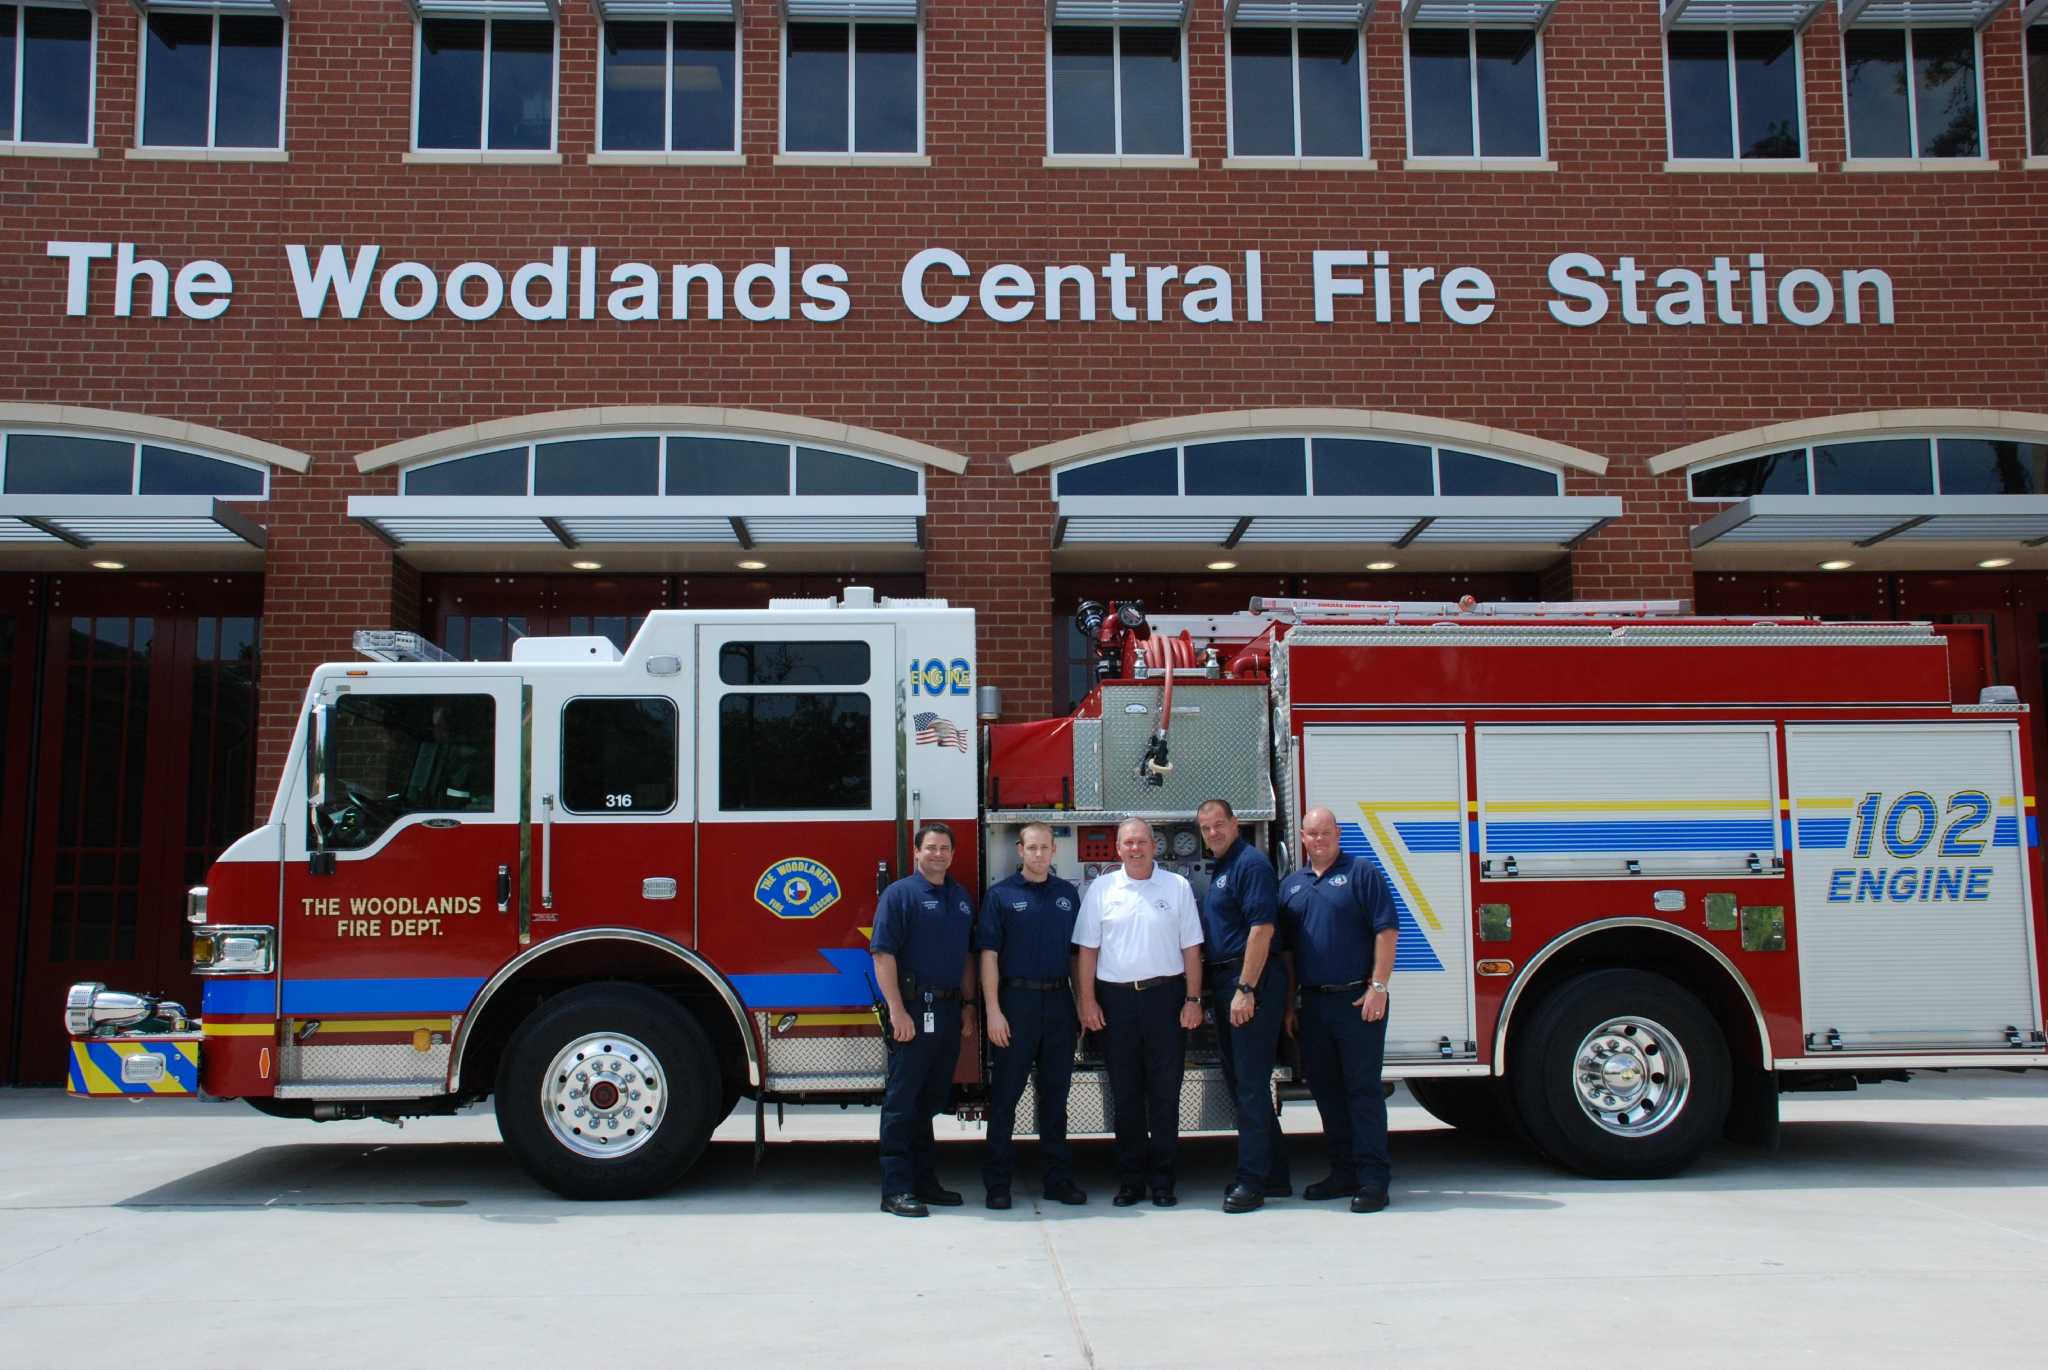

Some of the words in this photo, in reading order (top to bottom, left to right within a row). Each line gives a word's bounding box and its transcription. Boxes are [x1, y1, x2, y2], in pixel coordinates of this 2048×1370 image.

[46, 240, 233, 320] The
[285, 244, 851, 322] Woodlands
[901, 247, 1266, 322] Central
[1312, 249, 1496, 325] Fire
[1547, 252, 1895, 326] Station
[910, 658, 971, 697] 102
[605, 794, 632, 808] 316
[1852, 790, 1992, 859] 102
[1826, 866, 1994, 904] ENGINE
[301, 898, 340, 916] THE
[350, 896, 482, 916] WOODLANDS
[337, 919, 382, 937] FIRE
[390, 918, 443, 937] DEPT.
